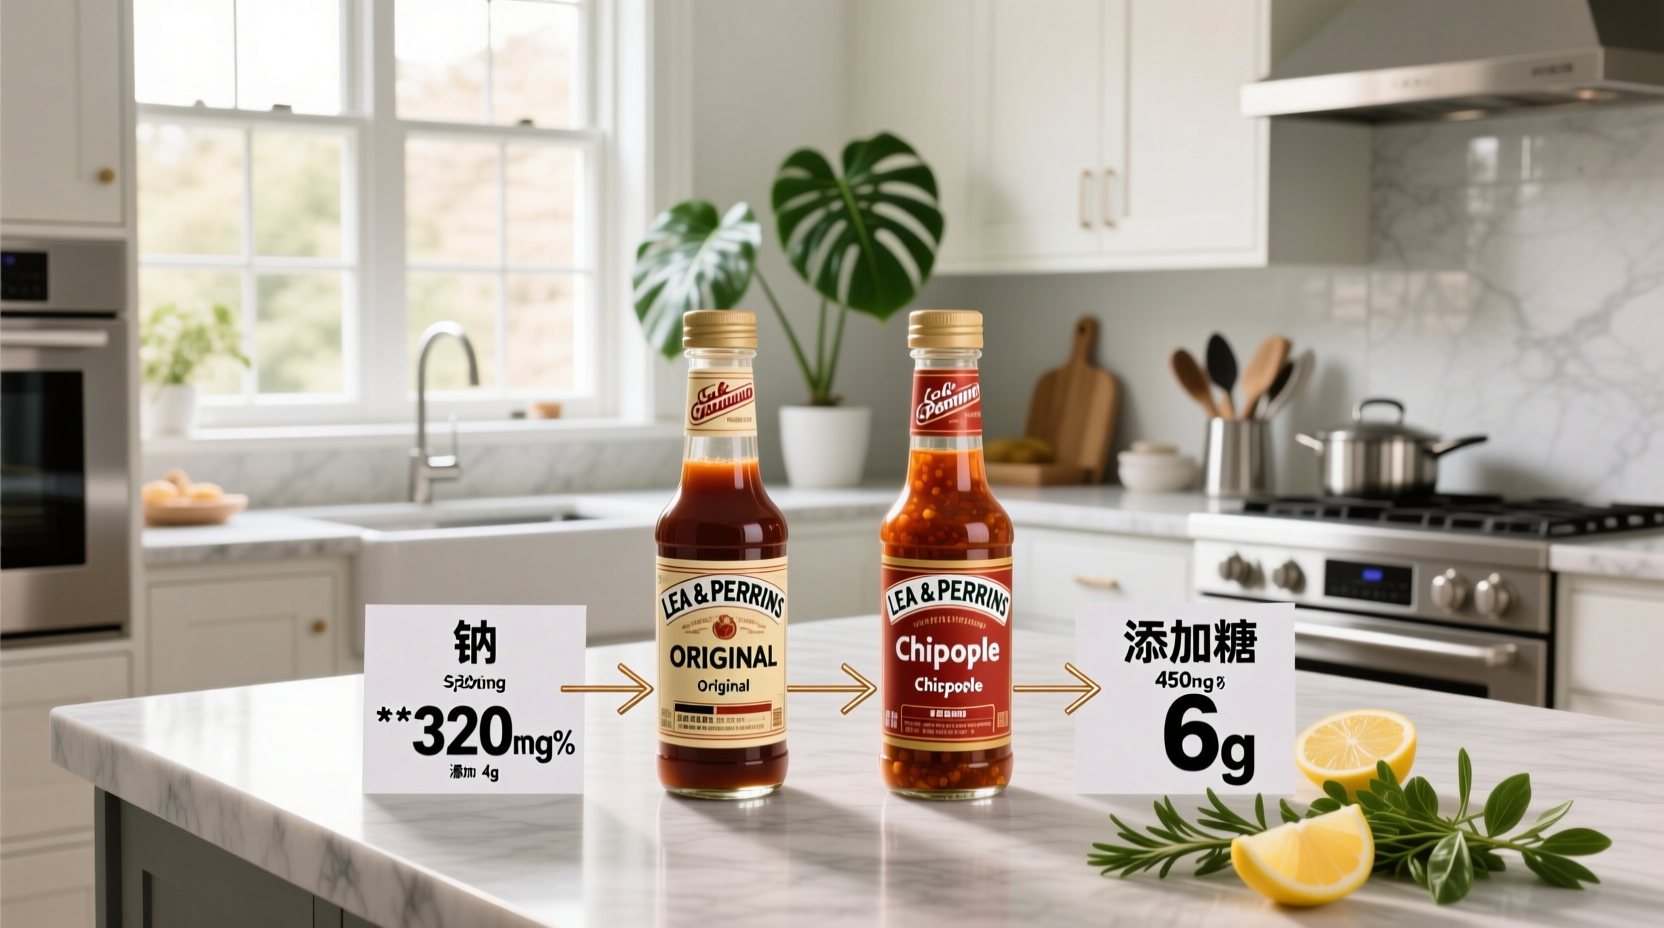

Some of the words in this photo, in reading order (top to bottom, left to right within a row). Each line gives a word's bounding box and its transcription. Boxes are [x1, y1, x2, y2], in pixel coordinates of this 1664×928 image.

[661, 590, 692, 620] LEA
[693, 582, 710, 605] &
[711, 579, 785, 619] PERRINS
[887, 586, 918, 616] LEA
[921, 582, 935, 603] &
[938, 579, 1009, 617] PERRINS
[453, 619, 496, 664] 钠
[669, 644, 778, 669] ORIGINAL
[895, 635, 1000, 670] Chipople
[1123, 619, 1258, 664] 添加糖
[697, 679, 750, 696] Original
[1163, 693, 1255, 786] 6g
[482, 764, 499, 782] 4g
